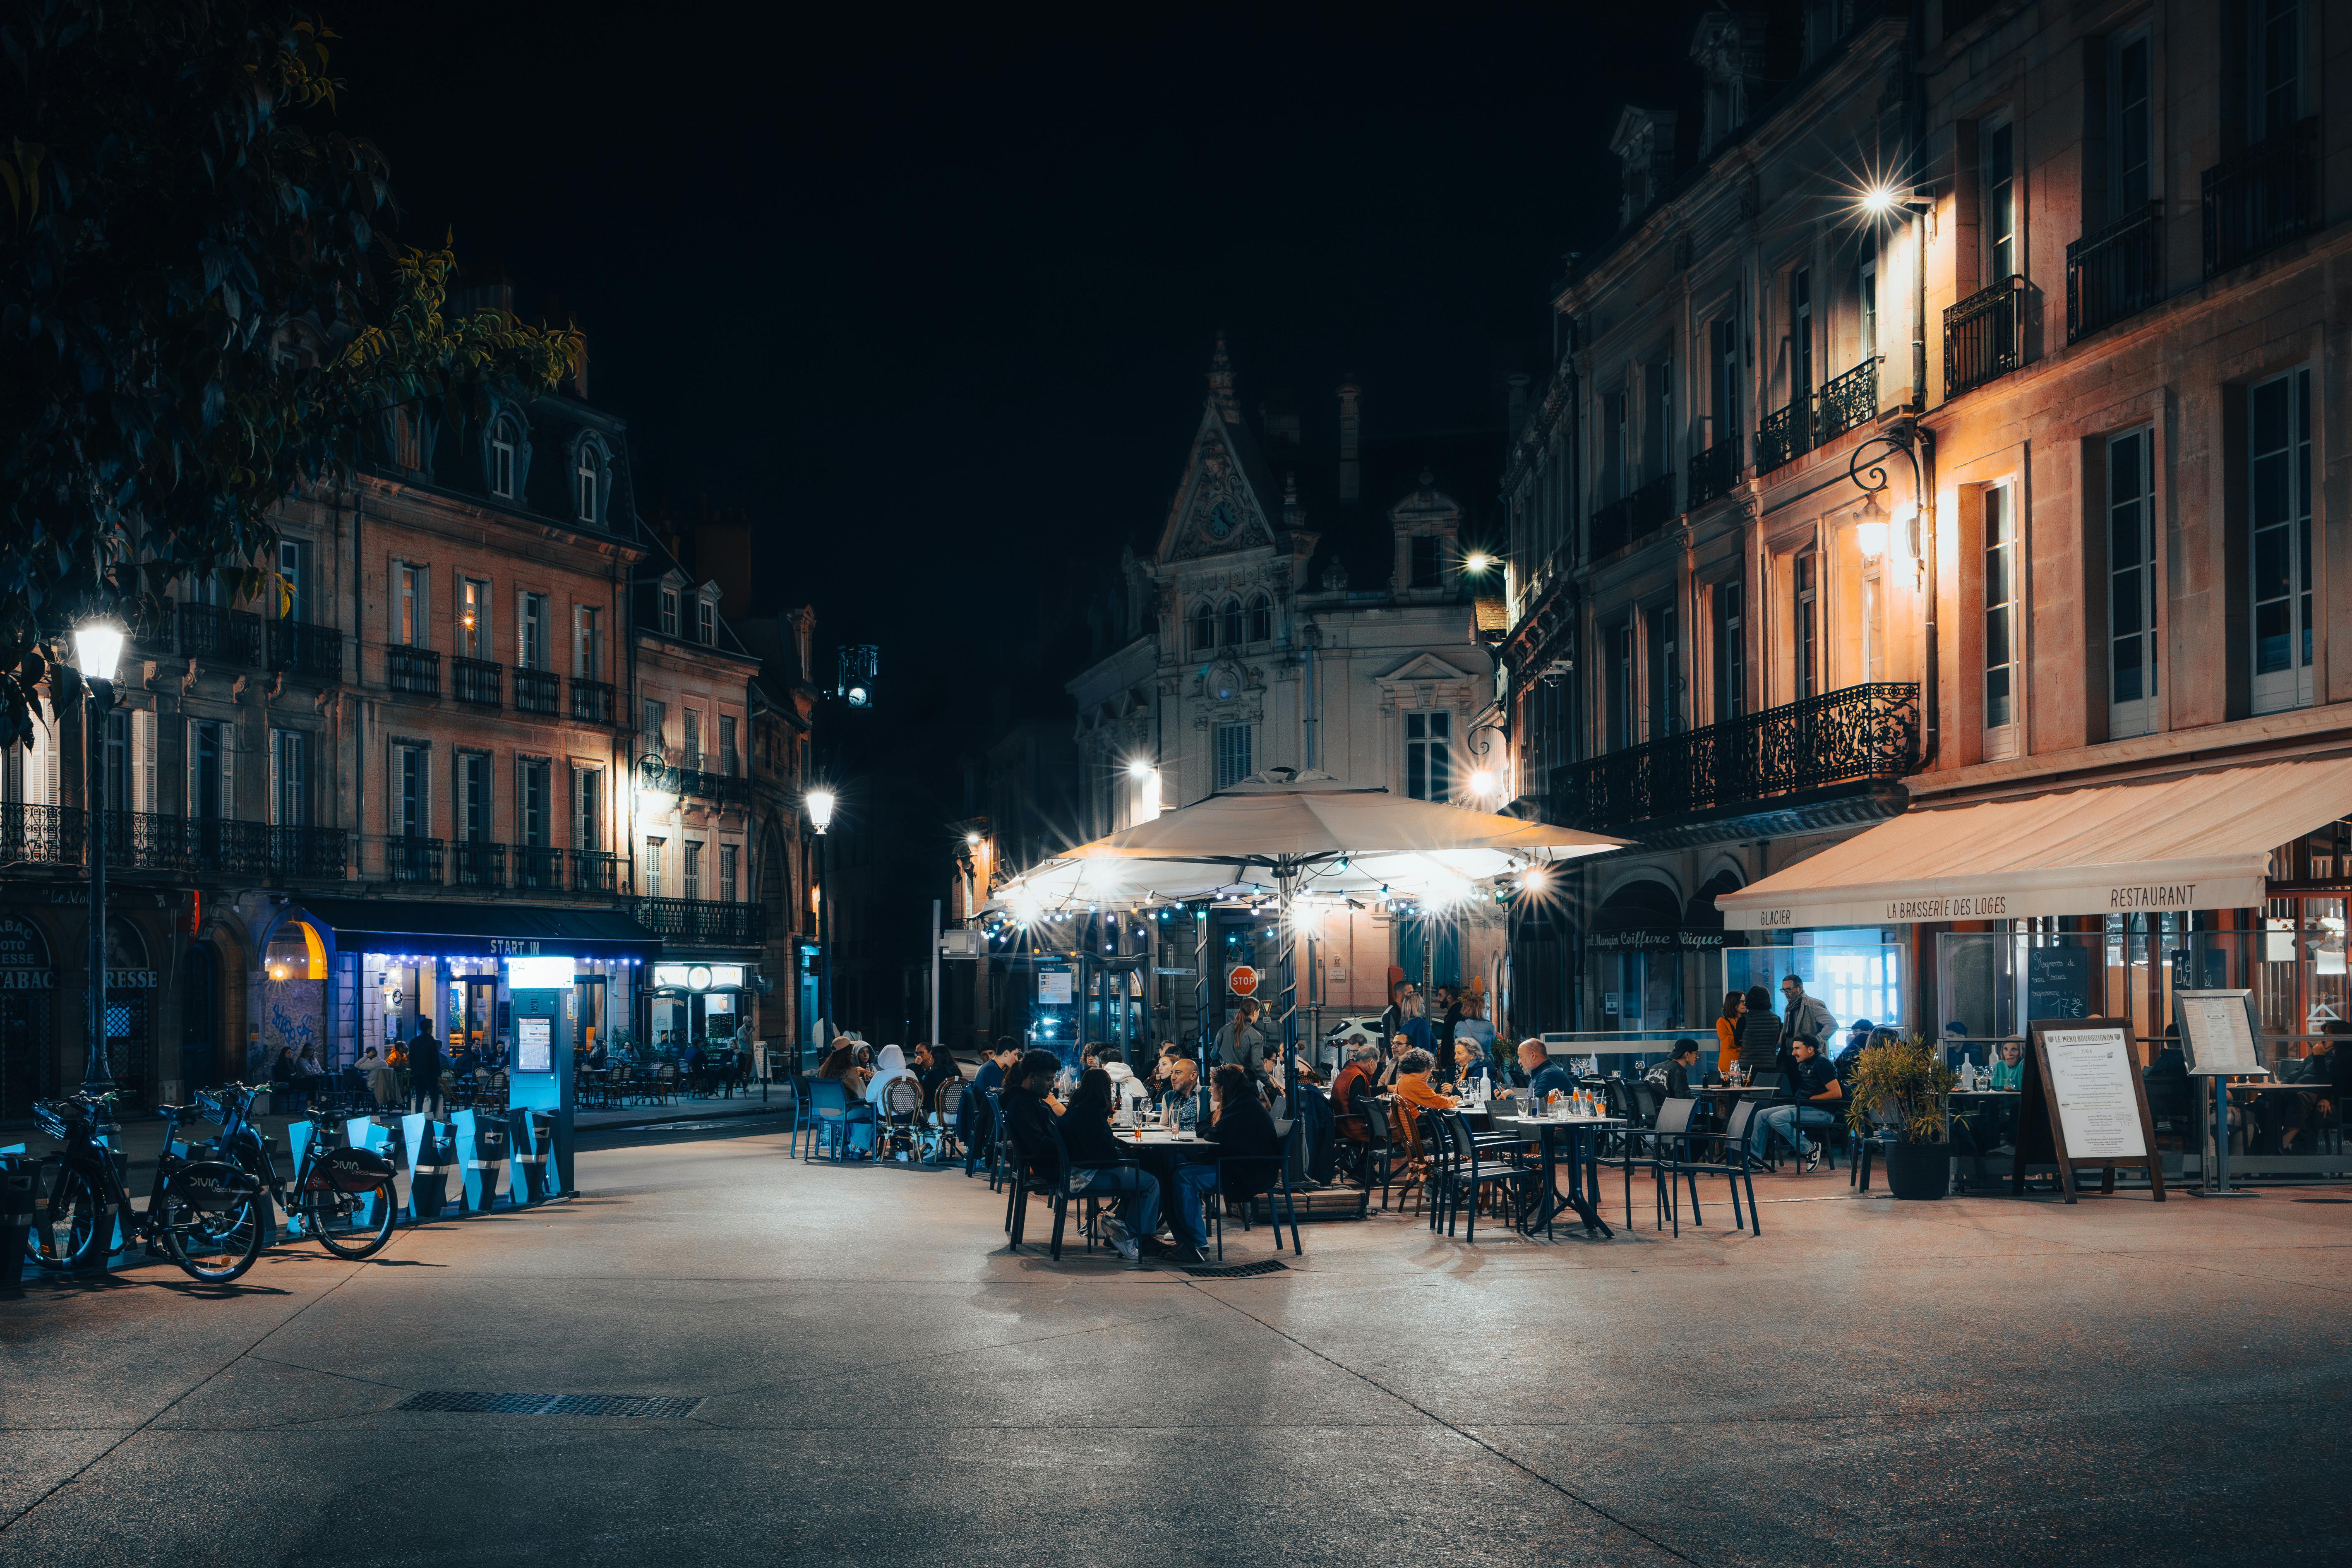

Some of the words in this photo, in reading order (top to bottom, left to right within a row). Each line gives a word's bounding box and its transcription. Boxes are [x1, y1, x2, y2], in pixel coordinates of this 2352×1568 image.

[2111, 884, 2196, 908] RESTAURANT
[1887, 903, 1896, 919] LA
[1900, 900, 1950, 918] BRASSERIE
[1954, 898, 1970, 916] DES
[1975, 897, 2006, 915] LOGES
[1761, 910, 1791, 925] GLACIER
[491, 939, 524, 955] START
[530, 941, 540, 956] IN
[1621, 931, 1671, 948] Coiffure
[1677, 931, 1724, 949] étique
[0, 953, 34, 964] ESSE
[106, 971, 158, 989] RESSE
[1233, 977, 1255, 985] STOP
[2078, 1034, 2114, 1042] BOURGUIGNON
